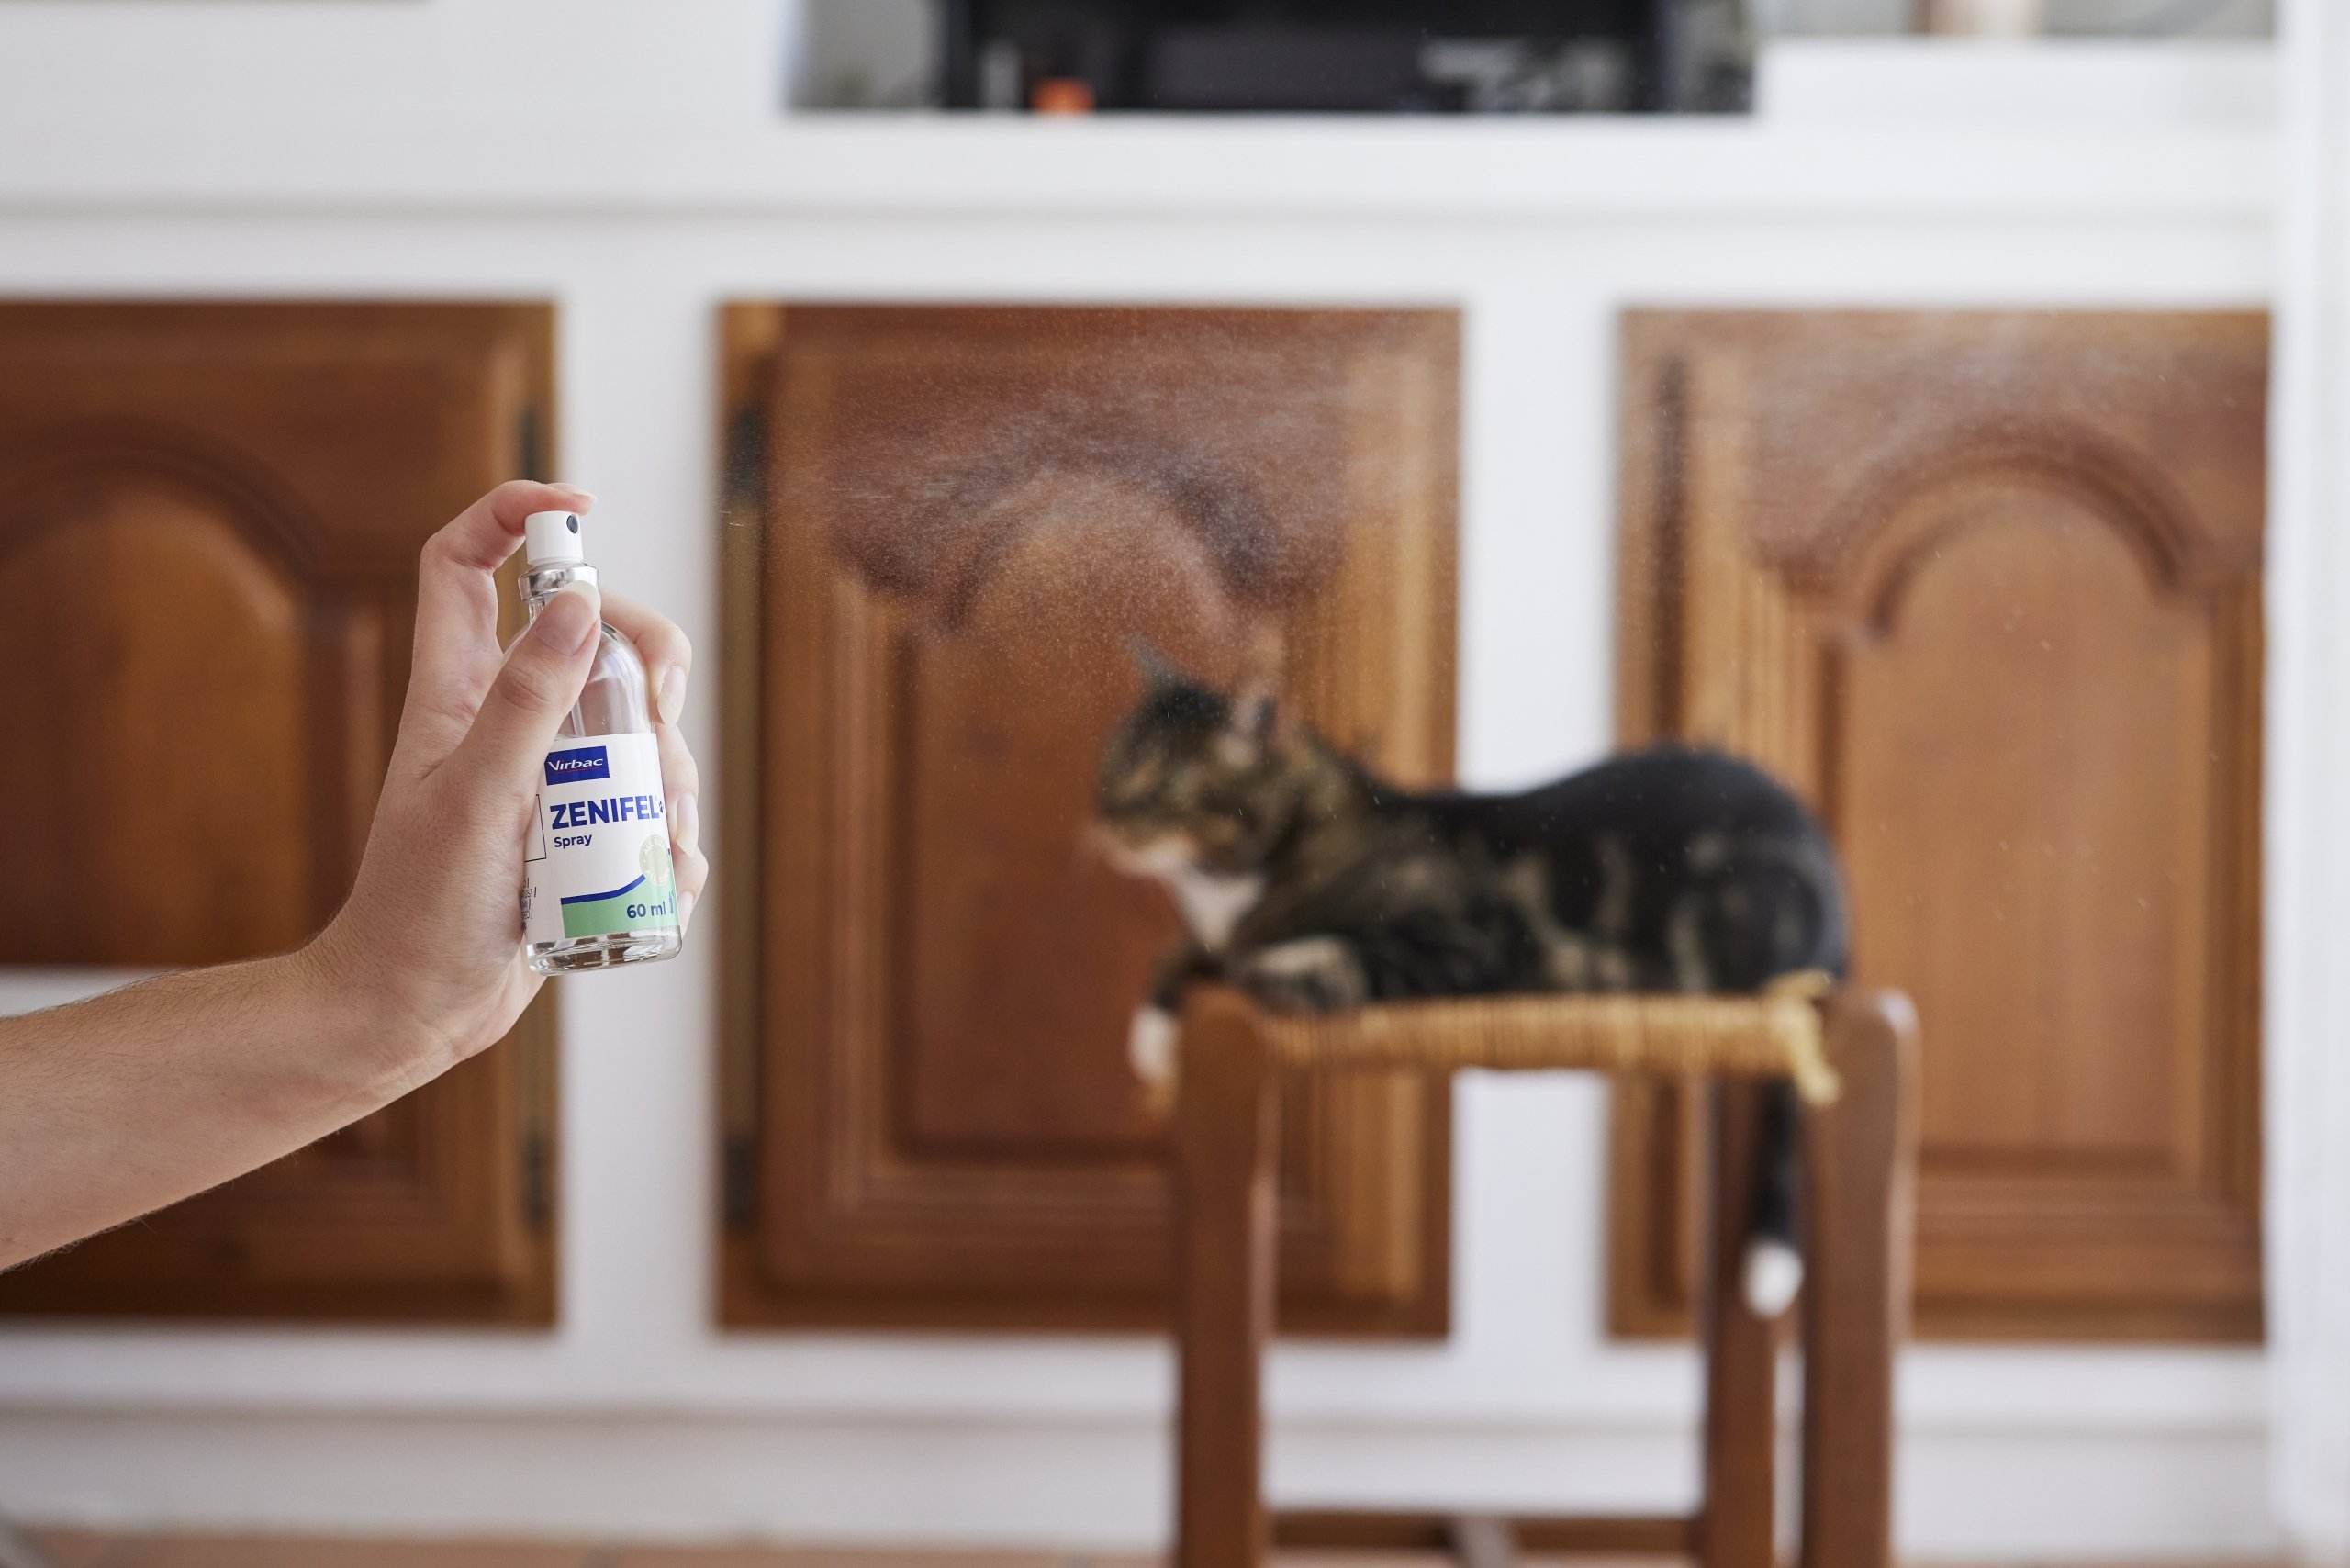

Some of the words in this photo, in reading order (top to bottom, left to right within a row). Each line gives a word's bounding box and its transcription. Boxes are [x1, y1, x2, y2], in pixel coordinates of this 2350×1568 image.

[548, 757, 604, 772] Virbac
[554, 834, 593, 849] Spray
[626, 903, 647, 919] 60
[650, 902, 666, 916] ml
